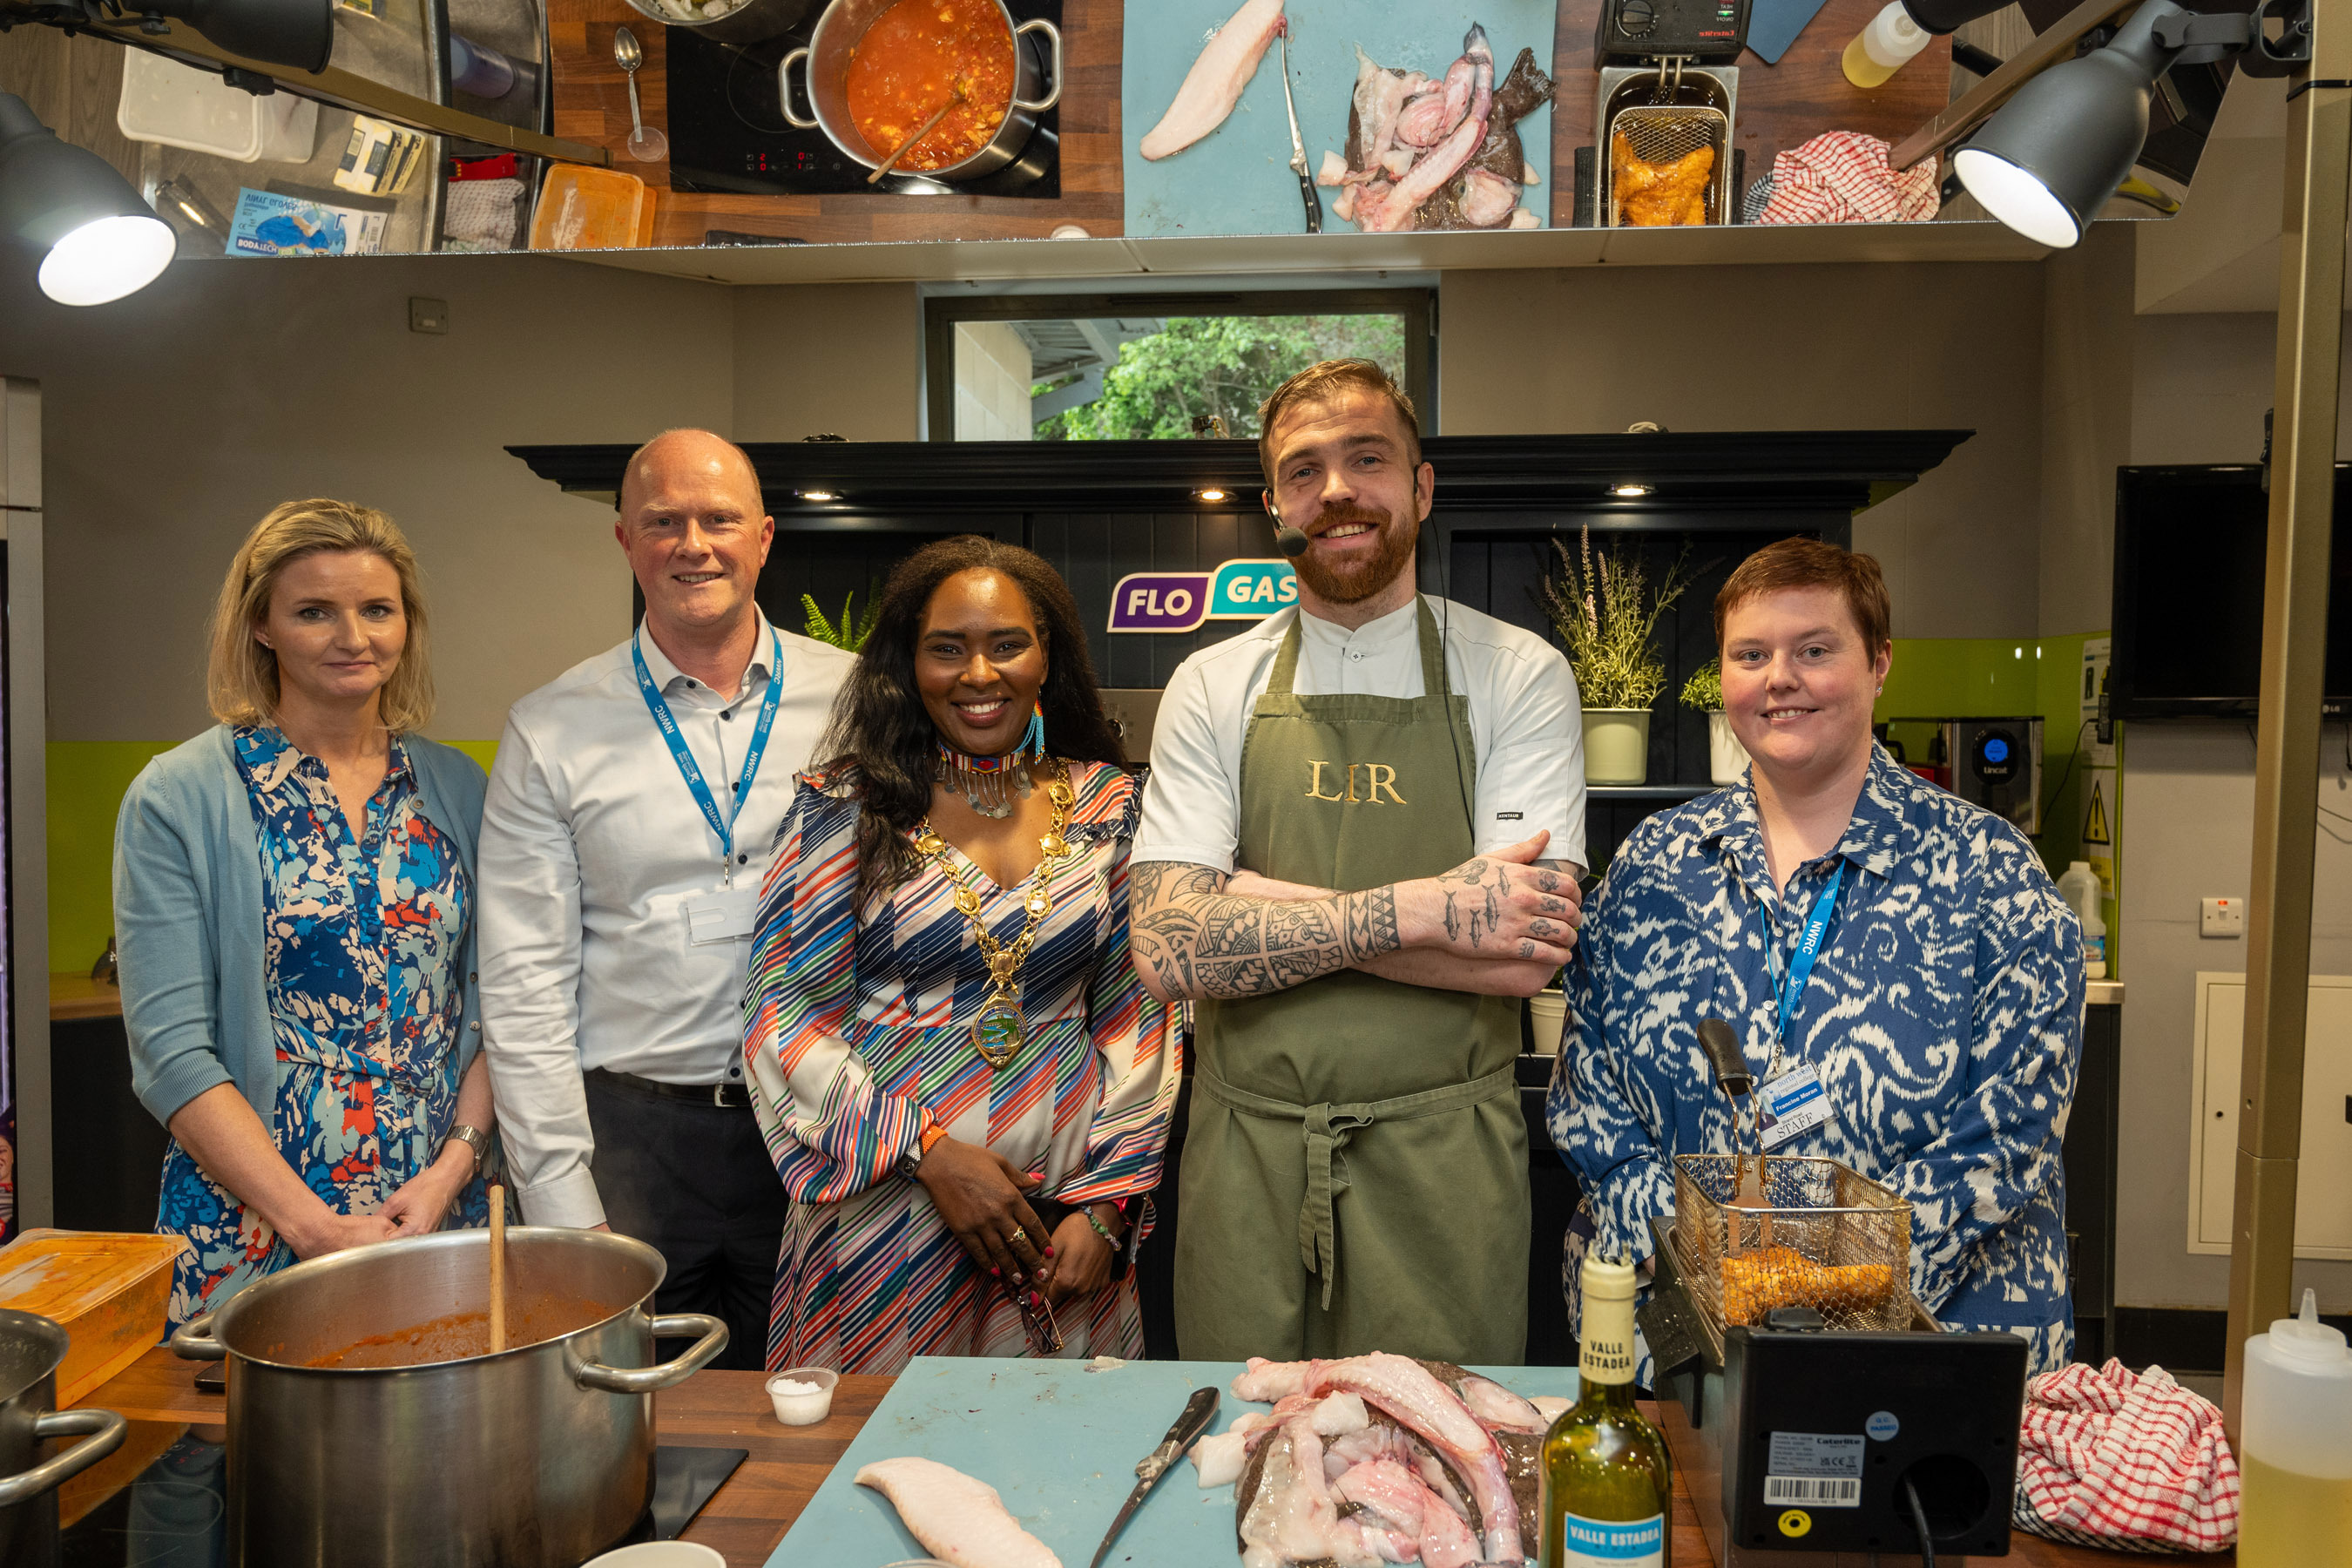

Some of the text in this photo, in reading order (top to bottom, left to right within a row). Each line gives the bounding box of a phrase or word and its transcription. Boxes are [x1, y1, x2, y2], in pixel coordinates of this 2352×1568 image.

[1127, 575, 1298, 617] FLO GAS
[774, 657, 782, 686] NWRC
[654, 705, 675, 734] NWRC
[744, 750, 759, 781] NWRC
[1304, 760, 1408, 804] LIR
[703, 801, 723, 831] NWRC
[1801, 920, 1823, 956] NWRC
[1777, 1072, 1796, 1088] north
[1780, 1080, 1799, 1094] regional
[1775, 1097, 1800, 1112] Francine
[1800, 1087, 1818, 1099] Moran
[1776, 1112, 1814, 1139] STAFF
[1584, 1352, 1631, 1369] ESTADEA
[1590, 1340, 1623, 1355] VALLE
[1570, 1524, 1659, 1546] VALLE ESTADEA
